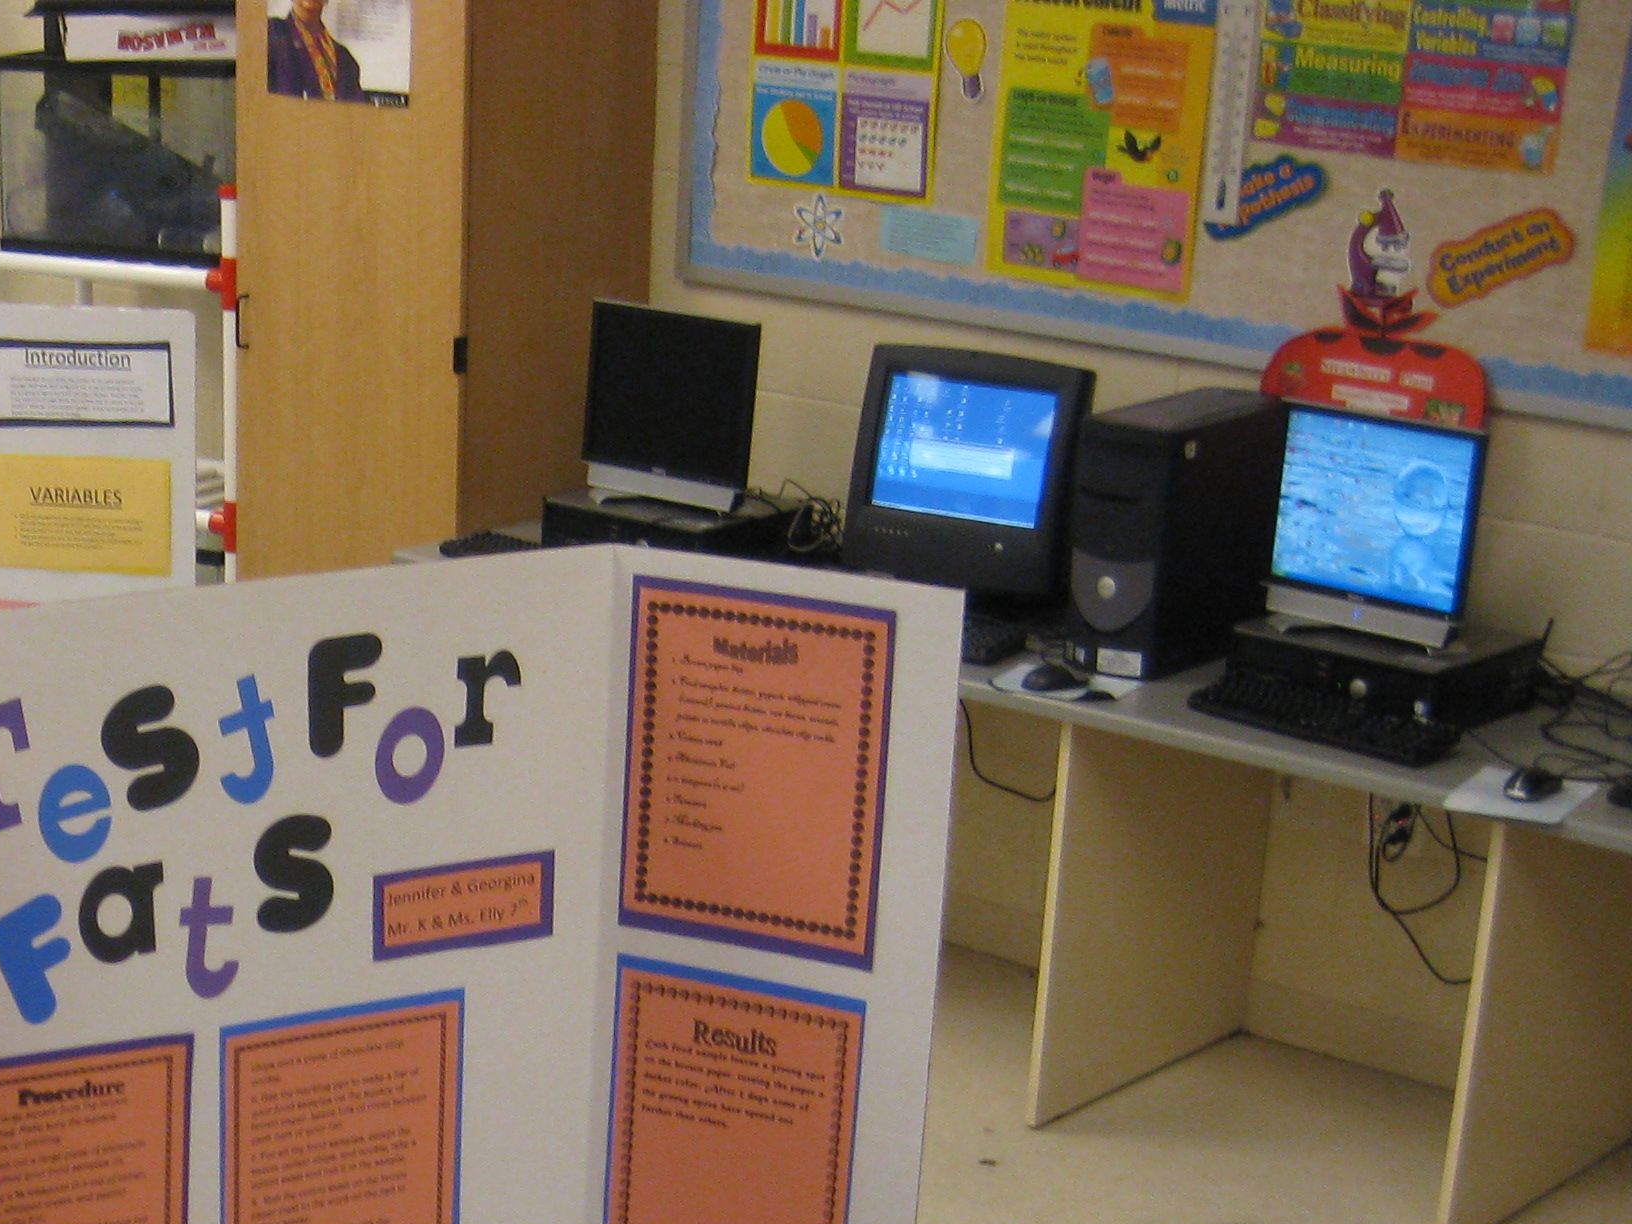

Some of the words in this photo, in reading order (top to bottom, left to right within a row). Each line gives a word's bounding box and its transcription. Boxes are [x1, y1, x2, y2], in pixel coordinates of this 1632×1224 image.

[1294, 44, 1402, 83] Measuring
[1239, 171, 1277, 197] ake
[1240, 174, 1316, 225] pothesis
[1441, 230, 1526, 273] Conduct
[1526, 220, 1552, 240] an
[1446, 234, 1562, 297] Experiment
[24, 348, 132, 369] Introduction
[29, 486, 124, 509] VARIABLES
[713, 635, 799, 665] Materials
[307, 632, 522, 805] For
[387, 883, 446, 909] Jennifer
[450, 881, 463, 896] &
[467, 872, 535, 892] Georgina
[387, 921, 412, 938] Mr.
[431, 916, 443, 930] &
[480, 907, 505, 924] Elly
[692, 1018, 778, 1058] Results
[18, 1078, 127, 1107] Procedure
